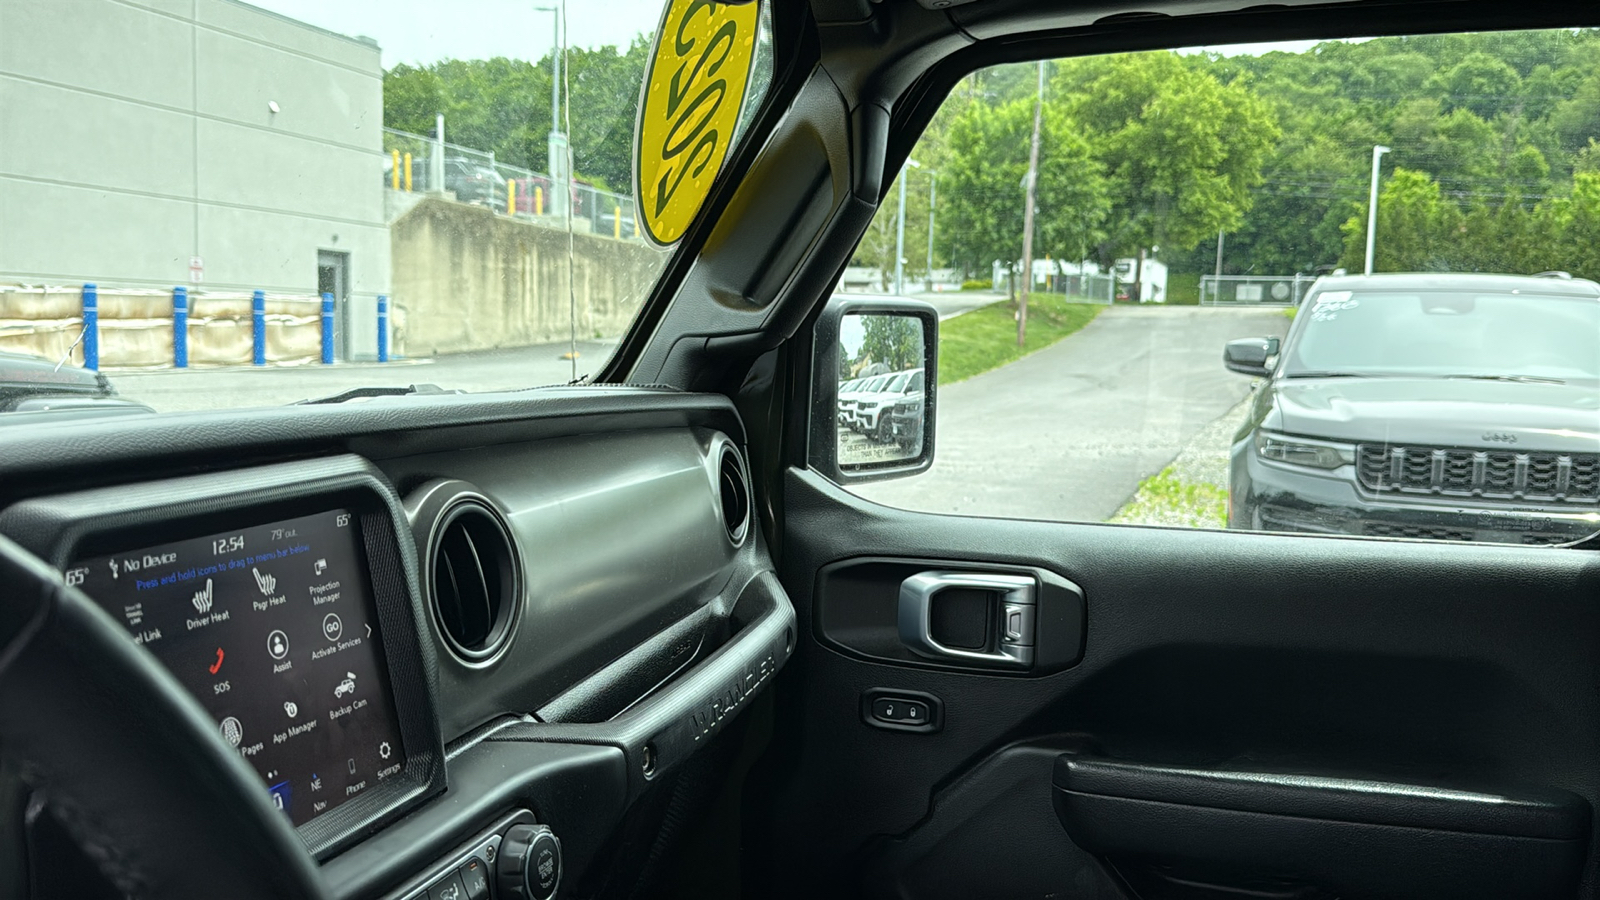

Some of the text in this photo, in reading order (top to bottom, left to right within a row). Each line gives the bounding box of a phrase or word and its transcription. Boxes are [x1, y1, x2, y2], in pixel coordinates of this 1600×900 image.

[1482, 431, 1517, 444] Jeep
[213, 535, 244, 555] 12:54
[124, 552, 177, 573] No Device
[136, 542, 310, 591] Press and hold icons to drag to menu bar below
[309, 580, 340, 595] Projection
[253, 594, 287, 611] Psgr Heat
[313, 592, 340, 606] Manager
[186, 609, 230, 631] Driver Heat
[326, 621, 339, 633] GO
[312, 637, 361, 660] Activate Services
[273, 660, 293, 674] Assist
[213, 680, 231, 695] SOS
[688, 651, 775, 742] WRANGLER
[329, 699, 368, 720] Backup Cam
[273, 719, 317, 744] App Manager
[241, 742, 264, 757] Pages
[377, 763, 400, 780] Settings
[310, 778, 323, 791] NE
[346, 780, 366, 796] Phone
[313, 800, 328, 813] Nav
[474, 876, 486, 891] A/C
